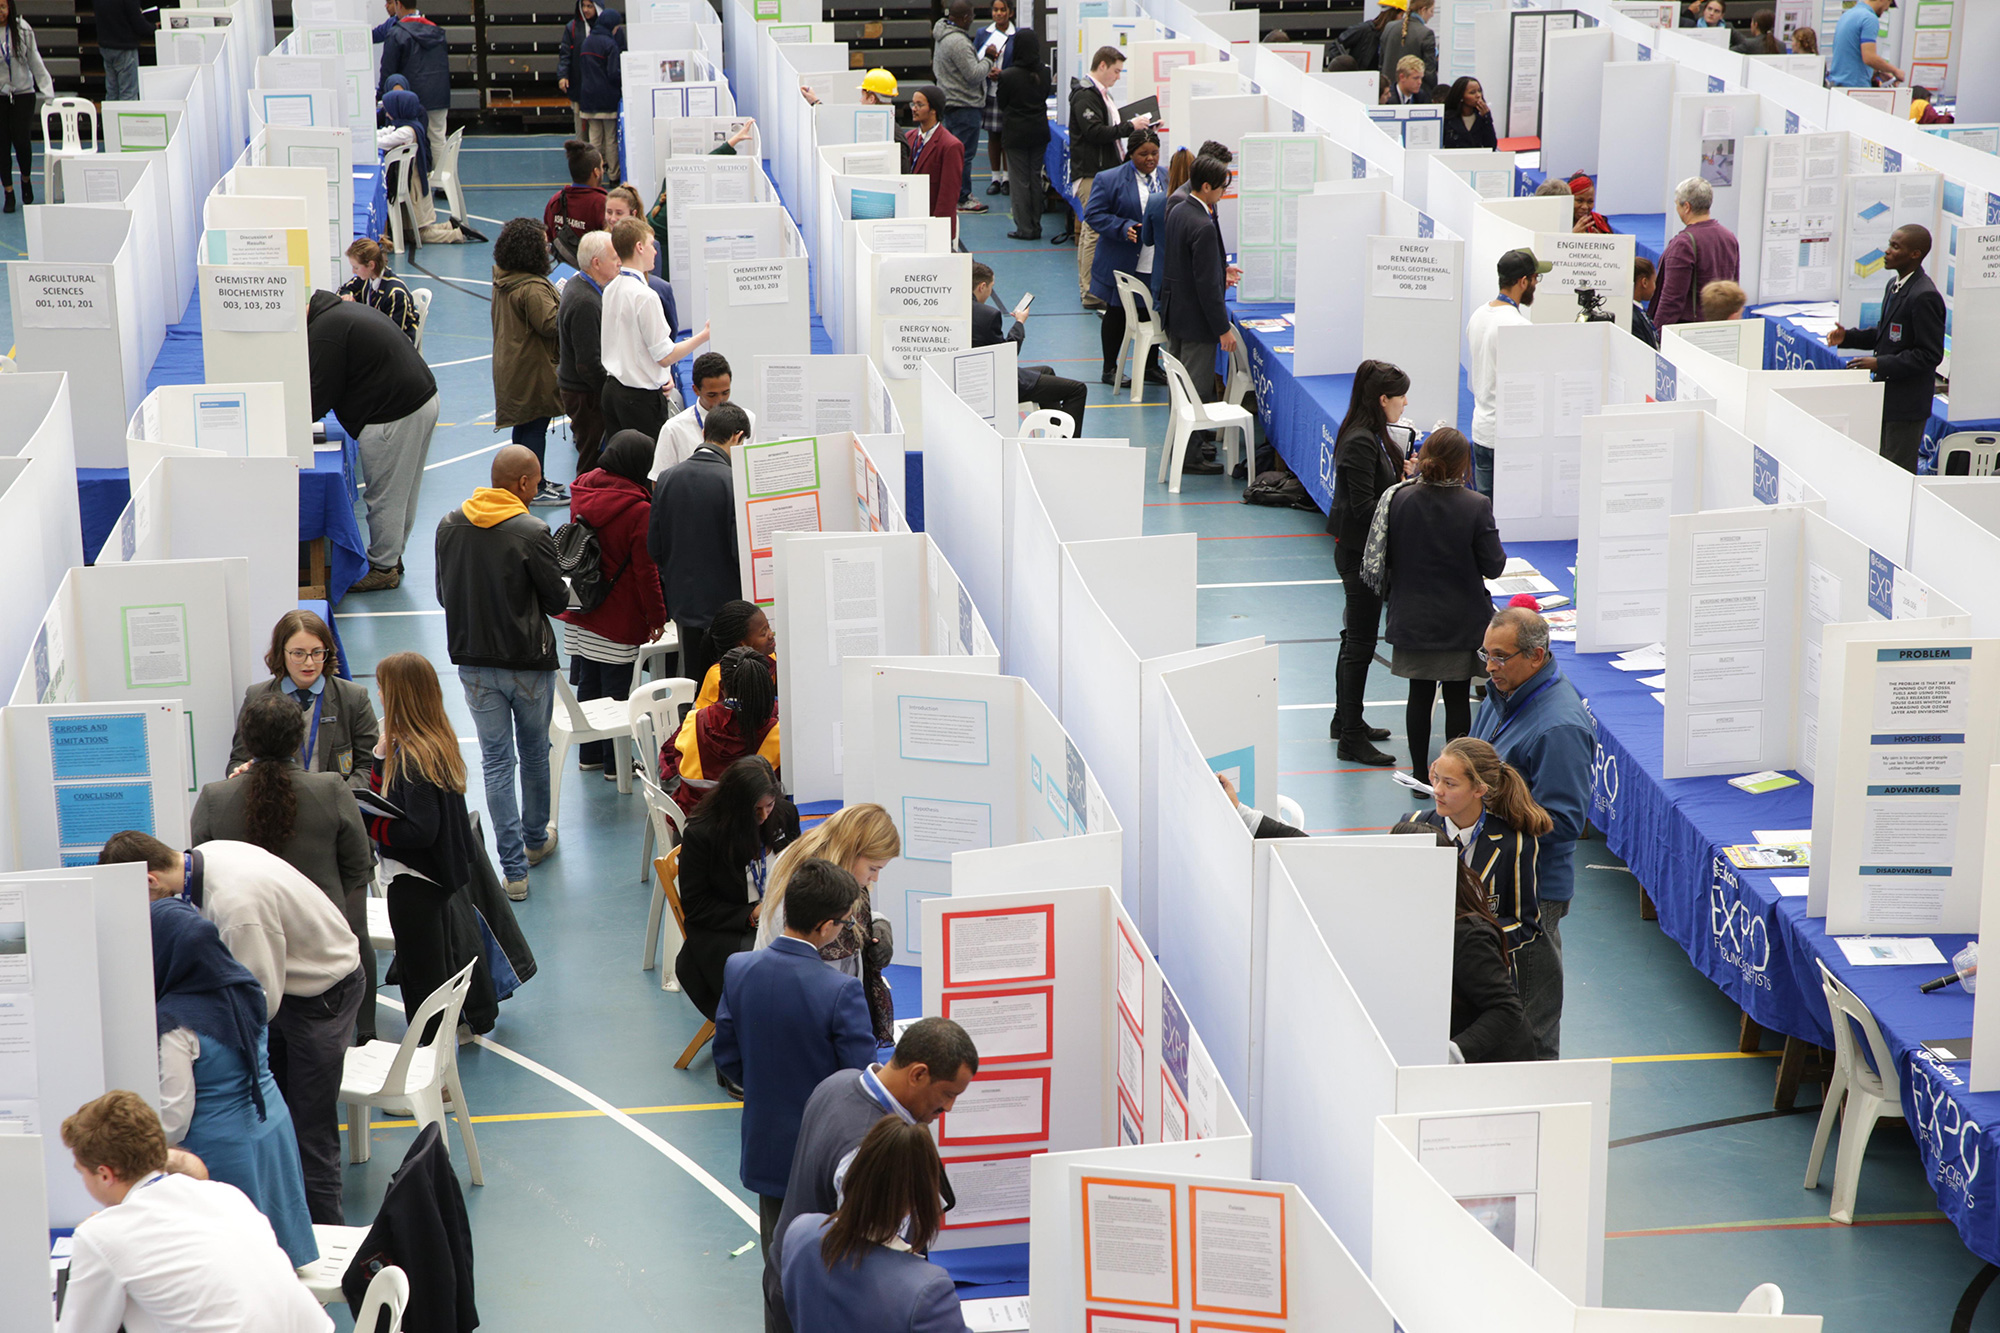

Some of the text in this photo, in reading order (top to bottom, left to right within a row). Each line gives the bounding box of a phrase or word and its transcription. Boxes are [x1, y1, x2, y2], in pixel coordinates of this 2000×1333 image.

[1400, 245, 1429, 253] ENERGY
[1557, 241, 1615, 250] ENGINEERING
[1391, 255, 1438, 264] RENEWABLE:
[733, 266, 768, 274] CHEMISTRY
[1408, 266, 1450, 274] GEOTHERMAL,
[28, 274, 96, 283] AGRICULTURAL
[214, 276, 287, 285] CHEMISTRY AND
[736, 274, 782, 282] BIOCHEMISTRY
[904, 274, 938, 282] ENERGY
[42, 287, 84, 296] SCIENCES
[219, 288, 284, 297] BIOCHEMISTRY
[890, 286, 952, 294] PRODUCTIVITY
[35, 300, 93, 308] 001, 101, 201
[223, 301, 281, 310] 003, 103, 203
[903, 298, 938, 307] 006, 206
[901, 336, 950, 344] RENEWABLE:
[1657, 369, 1676, 401] EXPO
[1755, 463, 1778, 499] EXPO
[1869, 569, 1892, 603] EXP
[1899, 650, 1950, 658] PROBLEM
[909, 704, 938, 712] Introduction
[55, 724, 108, 733] ERRORS AND
[56, 736, 109, 746] LIMITATIONS
[1884, 786, 1940, 794] ADVANTAGES
[73, 792, 124, 800] CONCLUSION
[1710, 884, 1770, 972] EXPO
[1162, 1008, 1188, 1079] EXPO
[1911, 1062, 1982, 1184] EXPO
